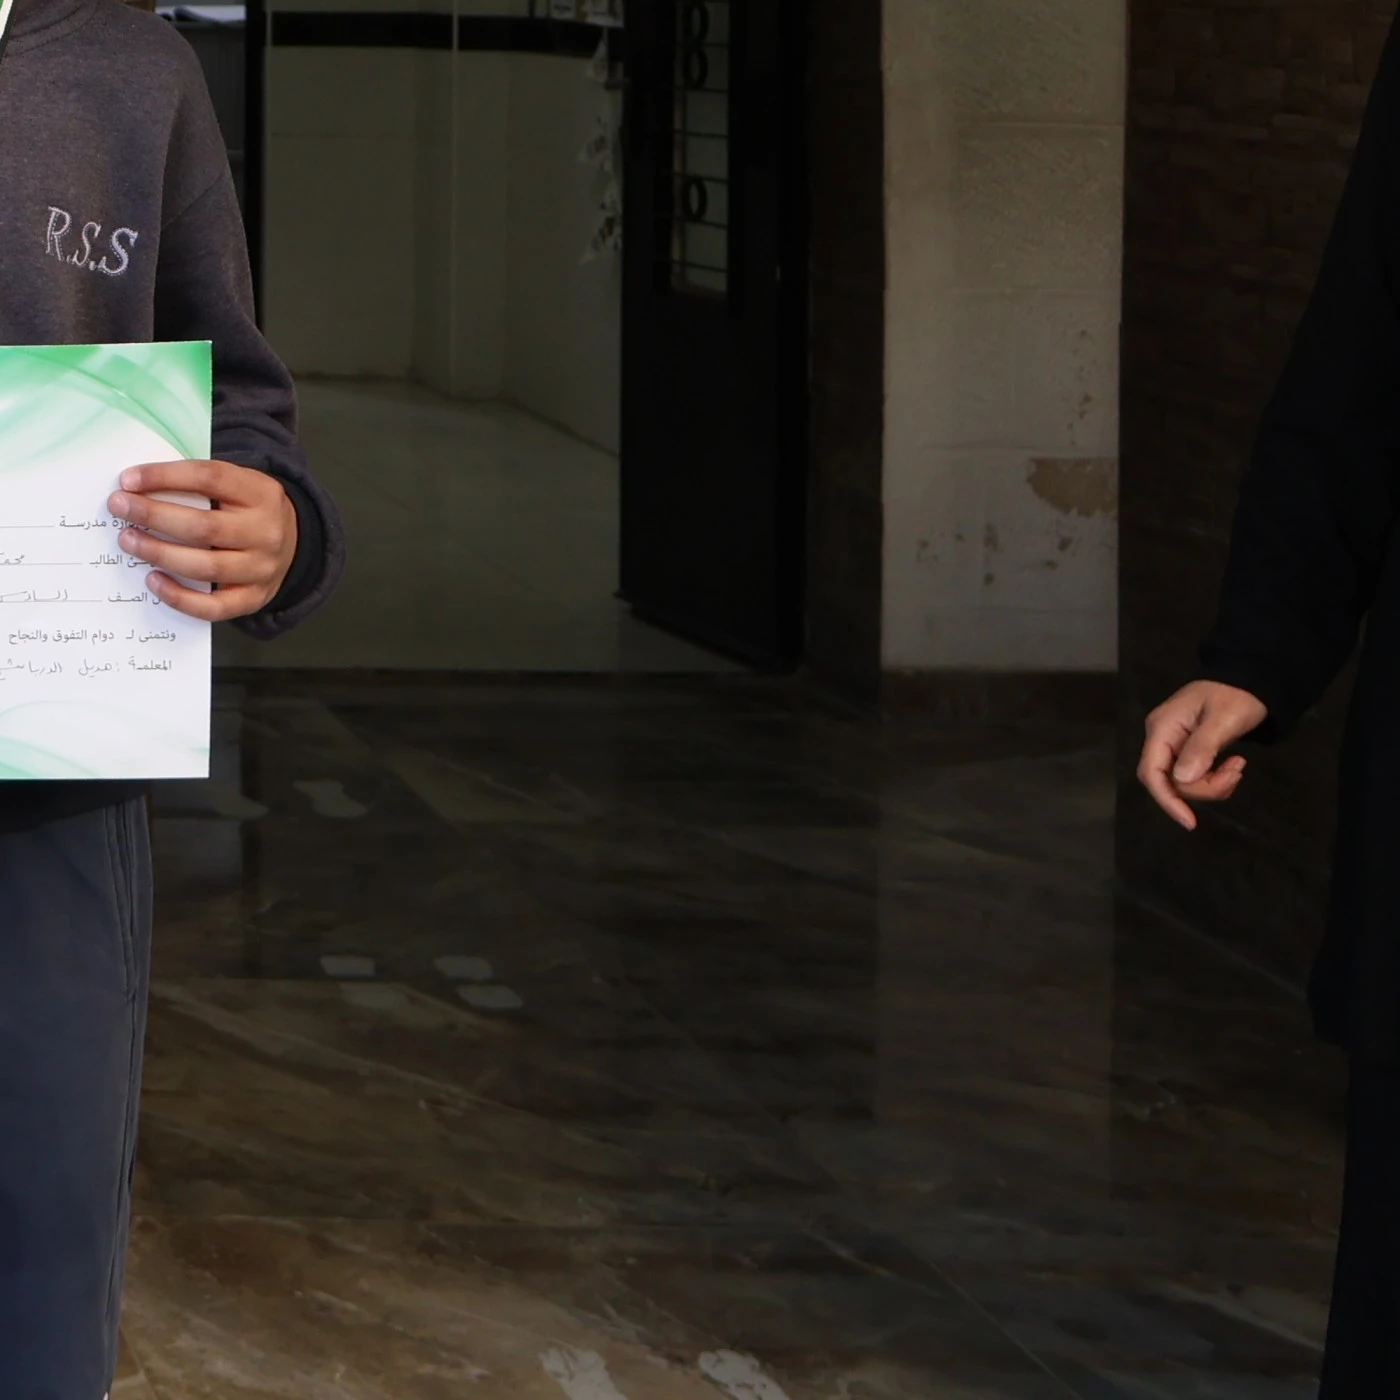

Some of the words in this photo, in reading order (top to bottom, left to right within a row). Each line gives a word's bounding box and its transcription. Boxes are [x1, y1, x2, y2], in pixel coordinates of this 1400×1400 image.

[8, 629, 49, 645] والنجاح
[52, 628, 88, 644] التفوق
[91, 629, 115, 645] دوام
